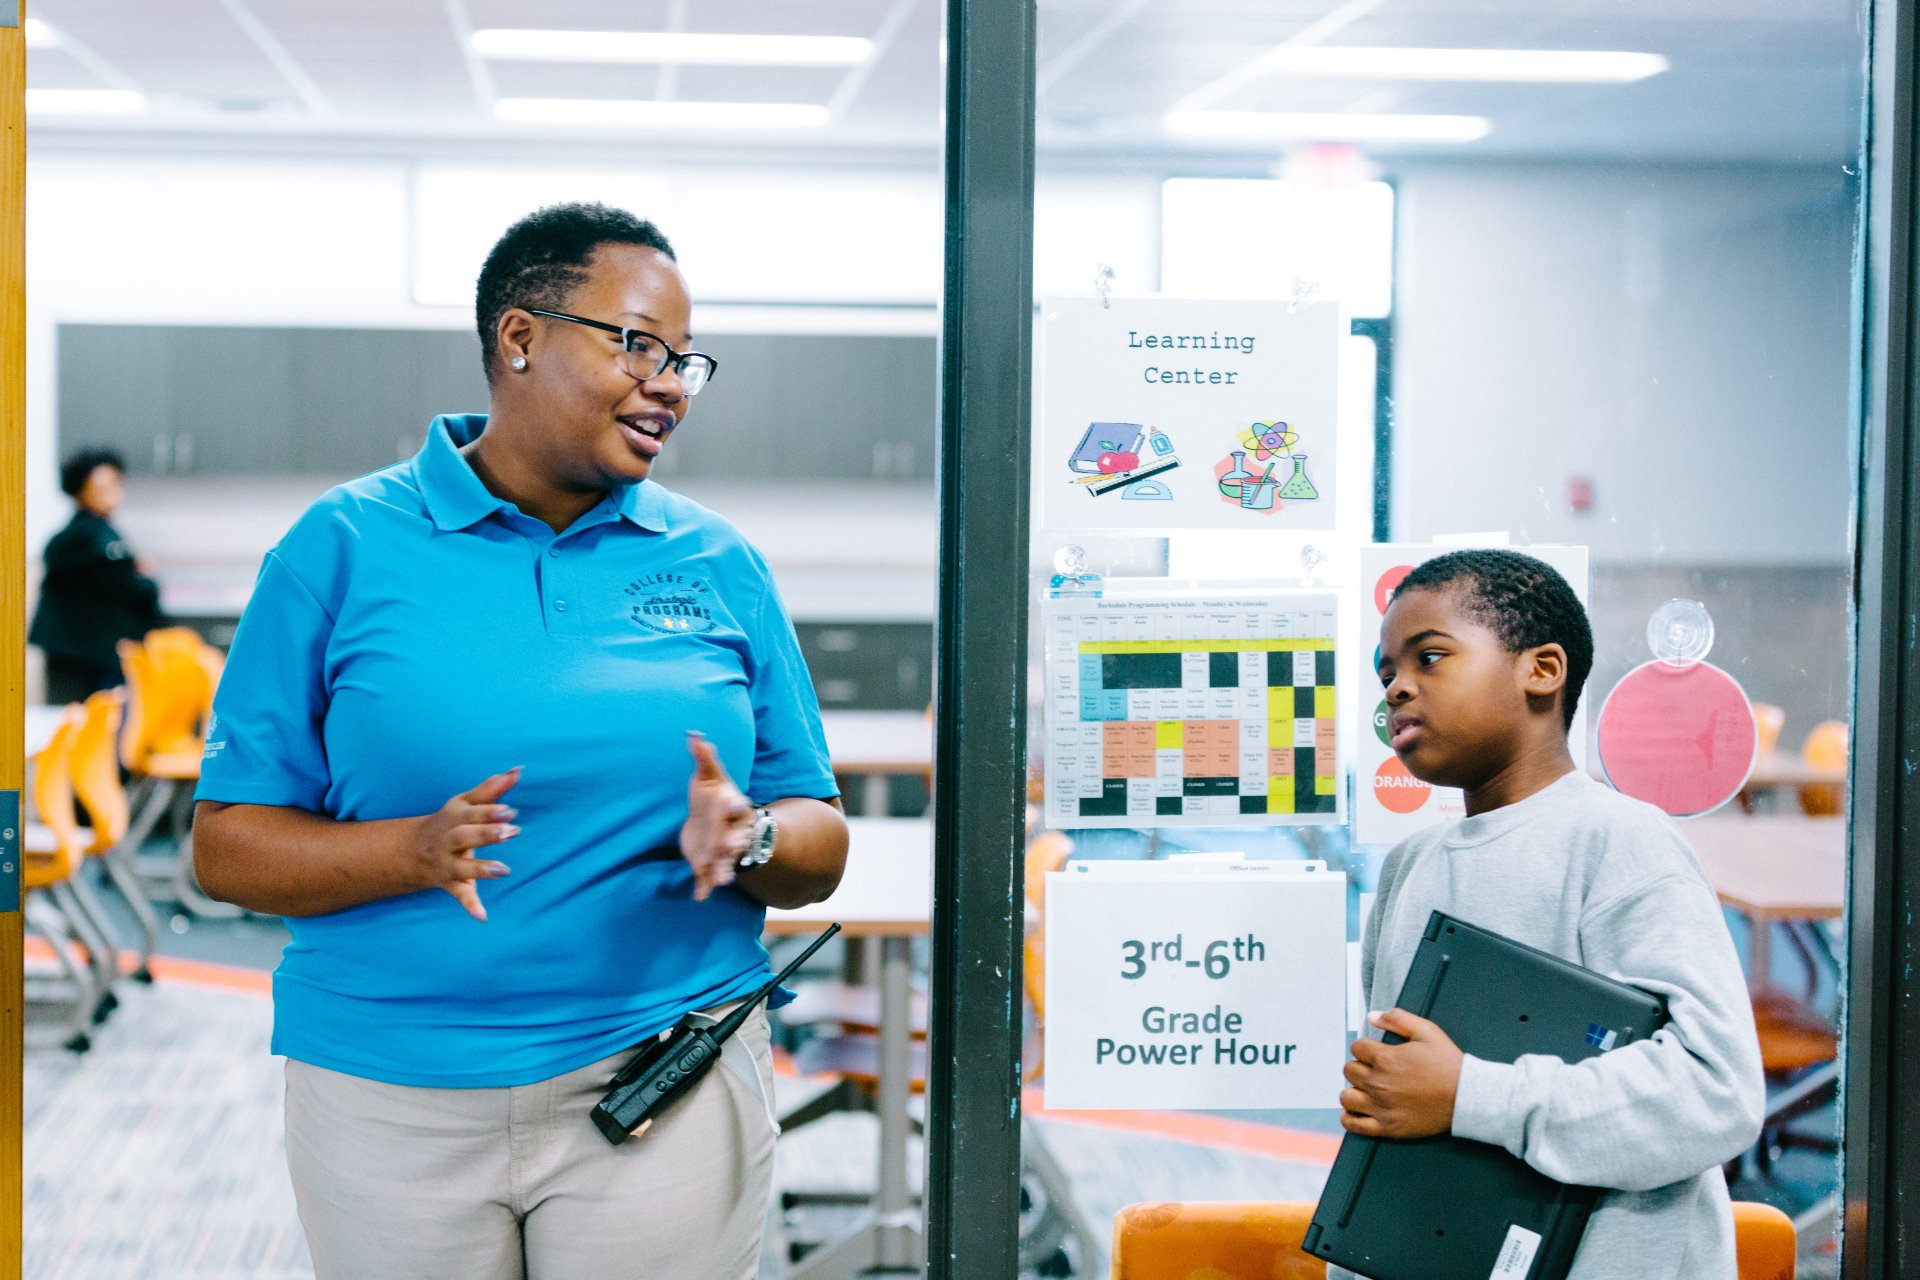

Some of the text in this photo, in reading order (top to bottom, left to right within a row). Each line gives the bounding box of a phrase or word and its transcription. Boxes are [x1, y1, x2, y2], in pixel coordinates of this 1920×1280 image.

[1128, 331, 1256, 355] Learning
[1143, 366, 1239, 386] Center
[624, 573, 709, 596] COLLEGE OF
[633, 605, 711, 620] PROGRAMS
[1120, 933, 1266, 980] 3rd-6th
[1141, 1004, 1243, 1034] Grade
[1096, 1038, 1297, 1065] Power Hour
